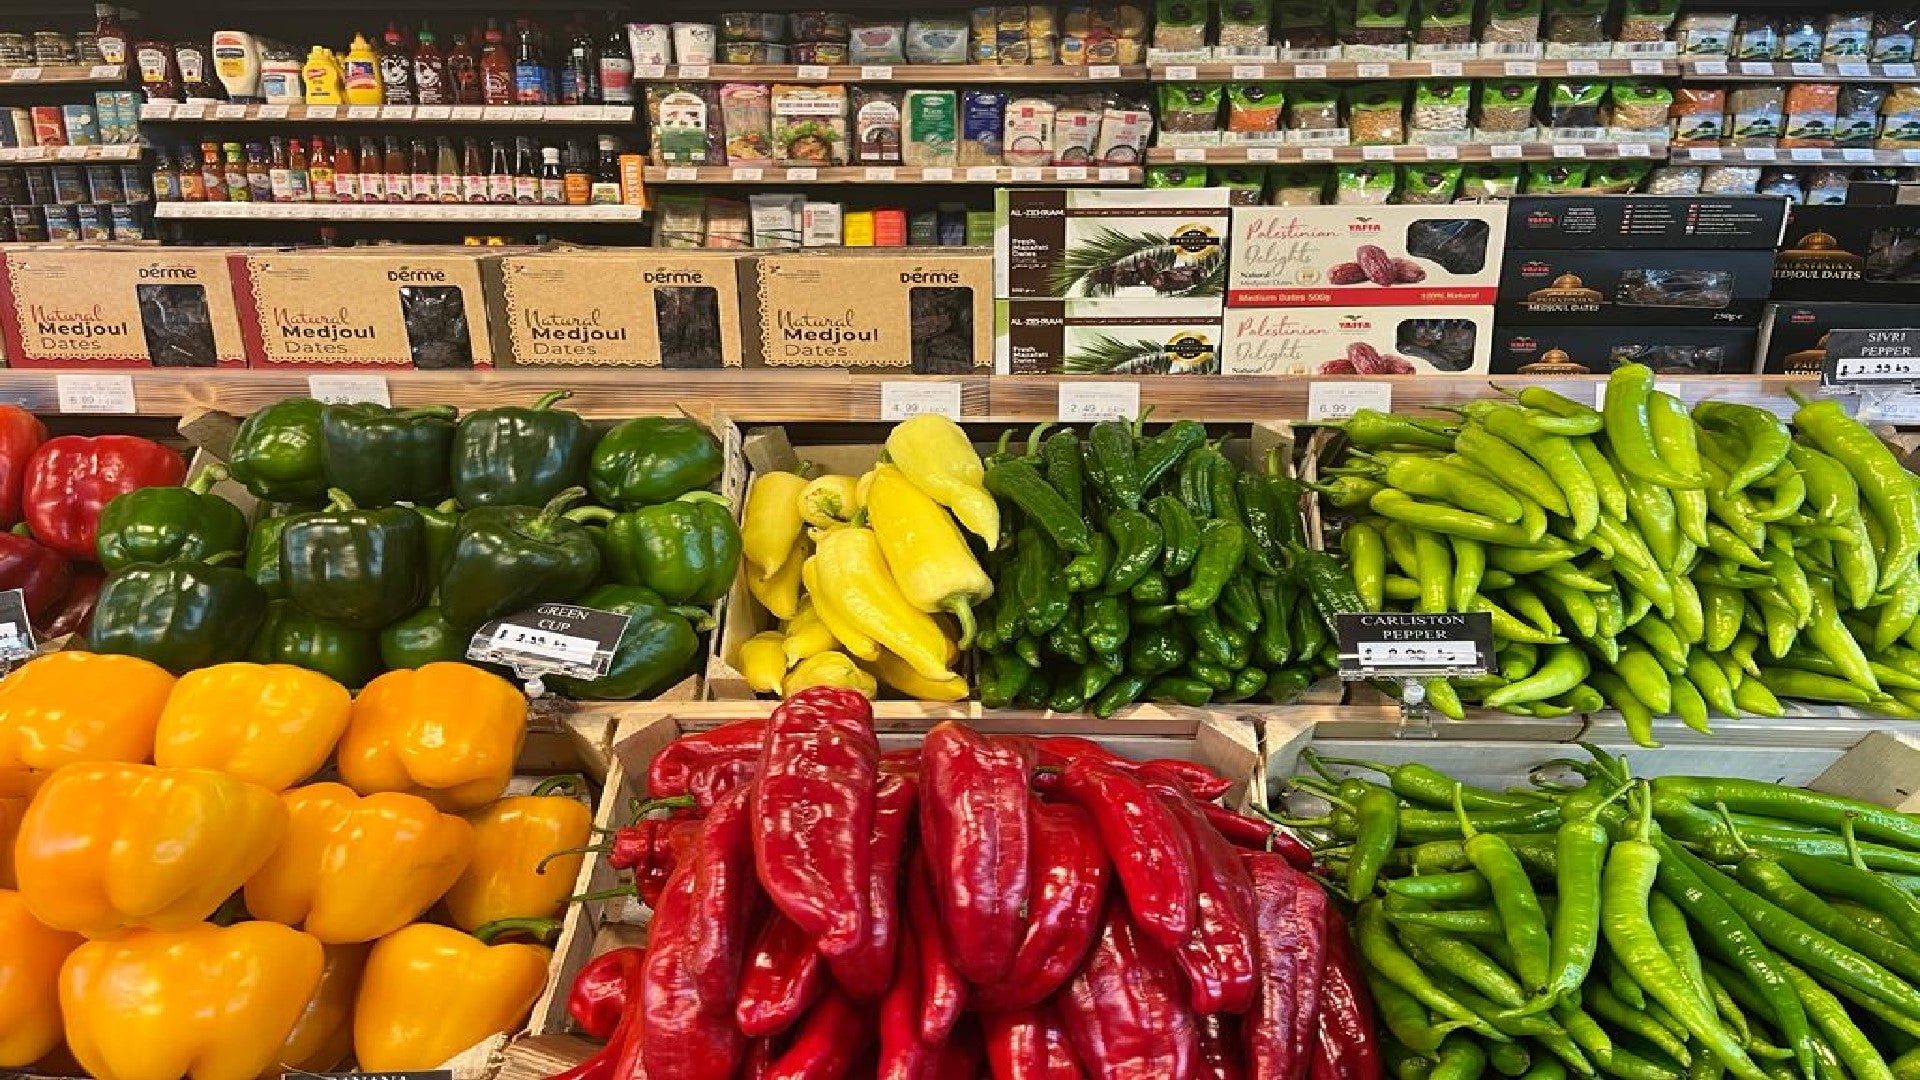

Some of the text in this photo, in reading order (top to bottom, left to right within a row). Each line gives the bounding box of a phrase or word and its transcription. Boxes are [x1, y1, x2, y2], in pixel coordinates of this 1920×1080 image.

[1246, 216, 1340, 241] Palestinian
[1244, 241, 1320, 277] Delights
[30, 304, 103, 322] Natural
[273, 307, 350, 327] Natural
[525, 308, 600, 328] Natural
[777, 309, 855, 329] Natural
[38, 321, 128, 337] Medjoul
[281, 325, 376, 341] Medjoul
[1236, 315, 1329, 338] Palestinian
[531, 327, 627, 343] Medjoul
[783, 328, 878, 345] Medjoul
[1868, 332, 1906, 343] SIVRI
[41, 337, 102, 350] Dates
[284, 341, 348, 354] Dates
[533, 343, 597, 355] Dates
[785, 344, 848, 357] Dates
[1861, 346, 1912, 357] PEPPER
[1236, 338, 1320, 372] Delights
[537, 606, 590, 620] GREEN
[1360, 615, 1465, 625] CARLISTON
[537, 619, 571, 631] CUP
[1383, 630, 1448, 639] PEPPER
